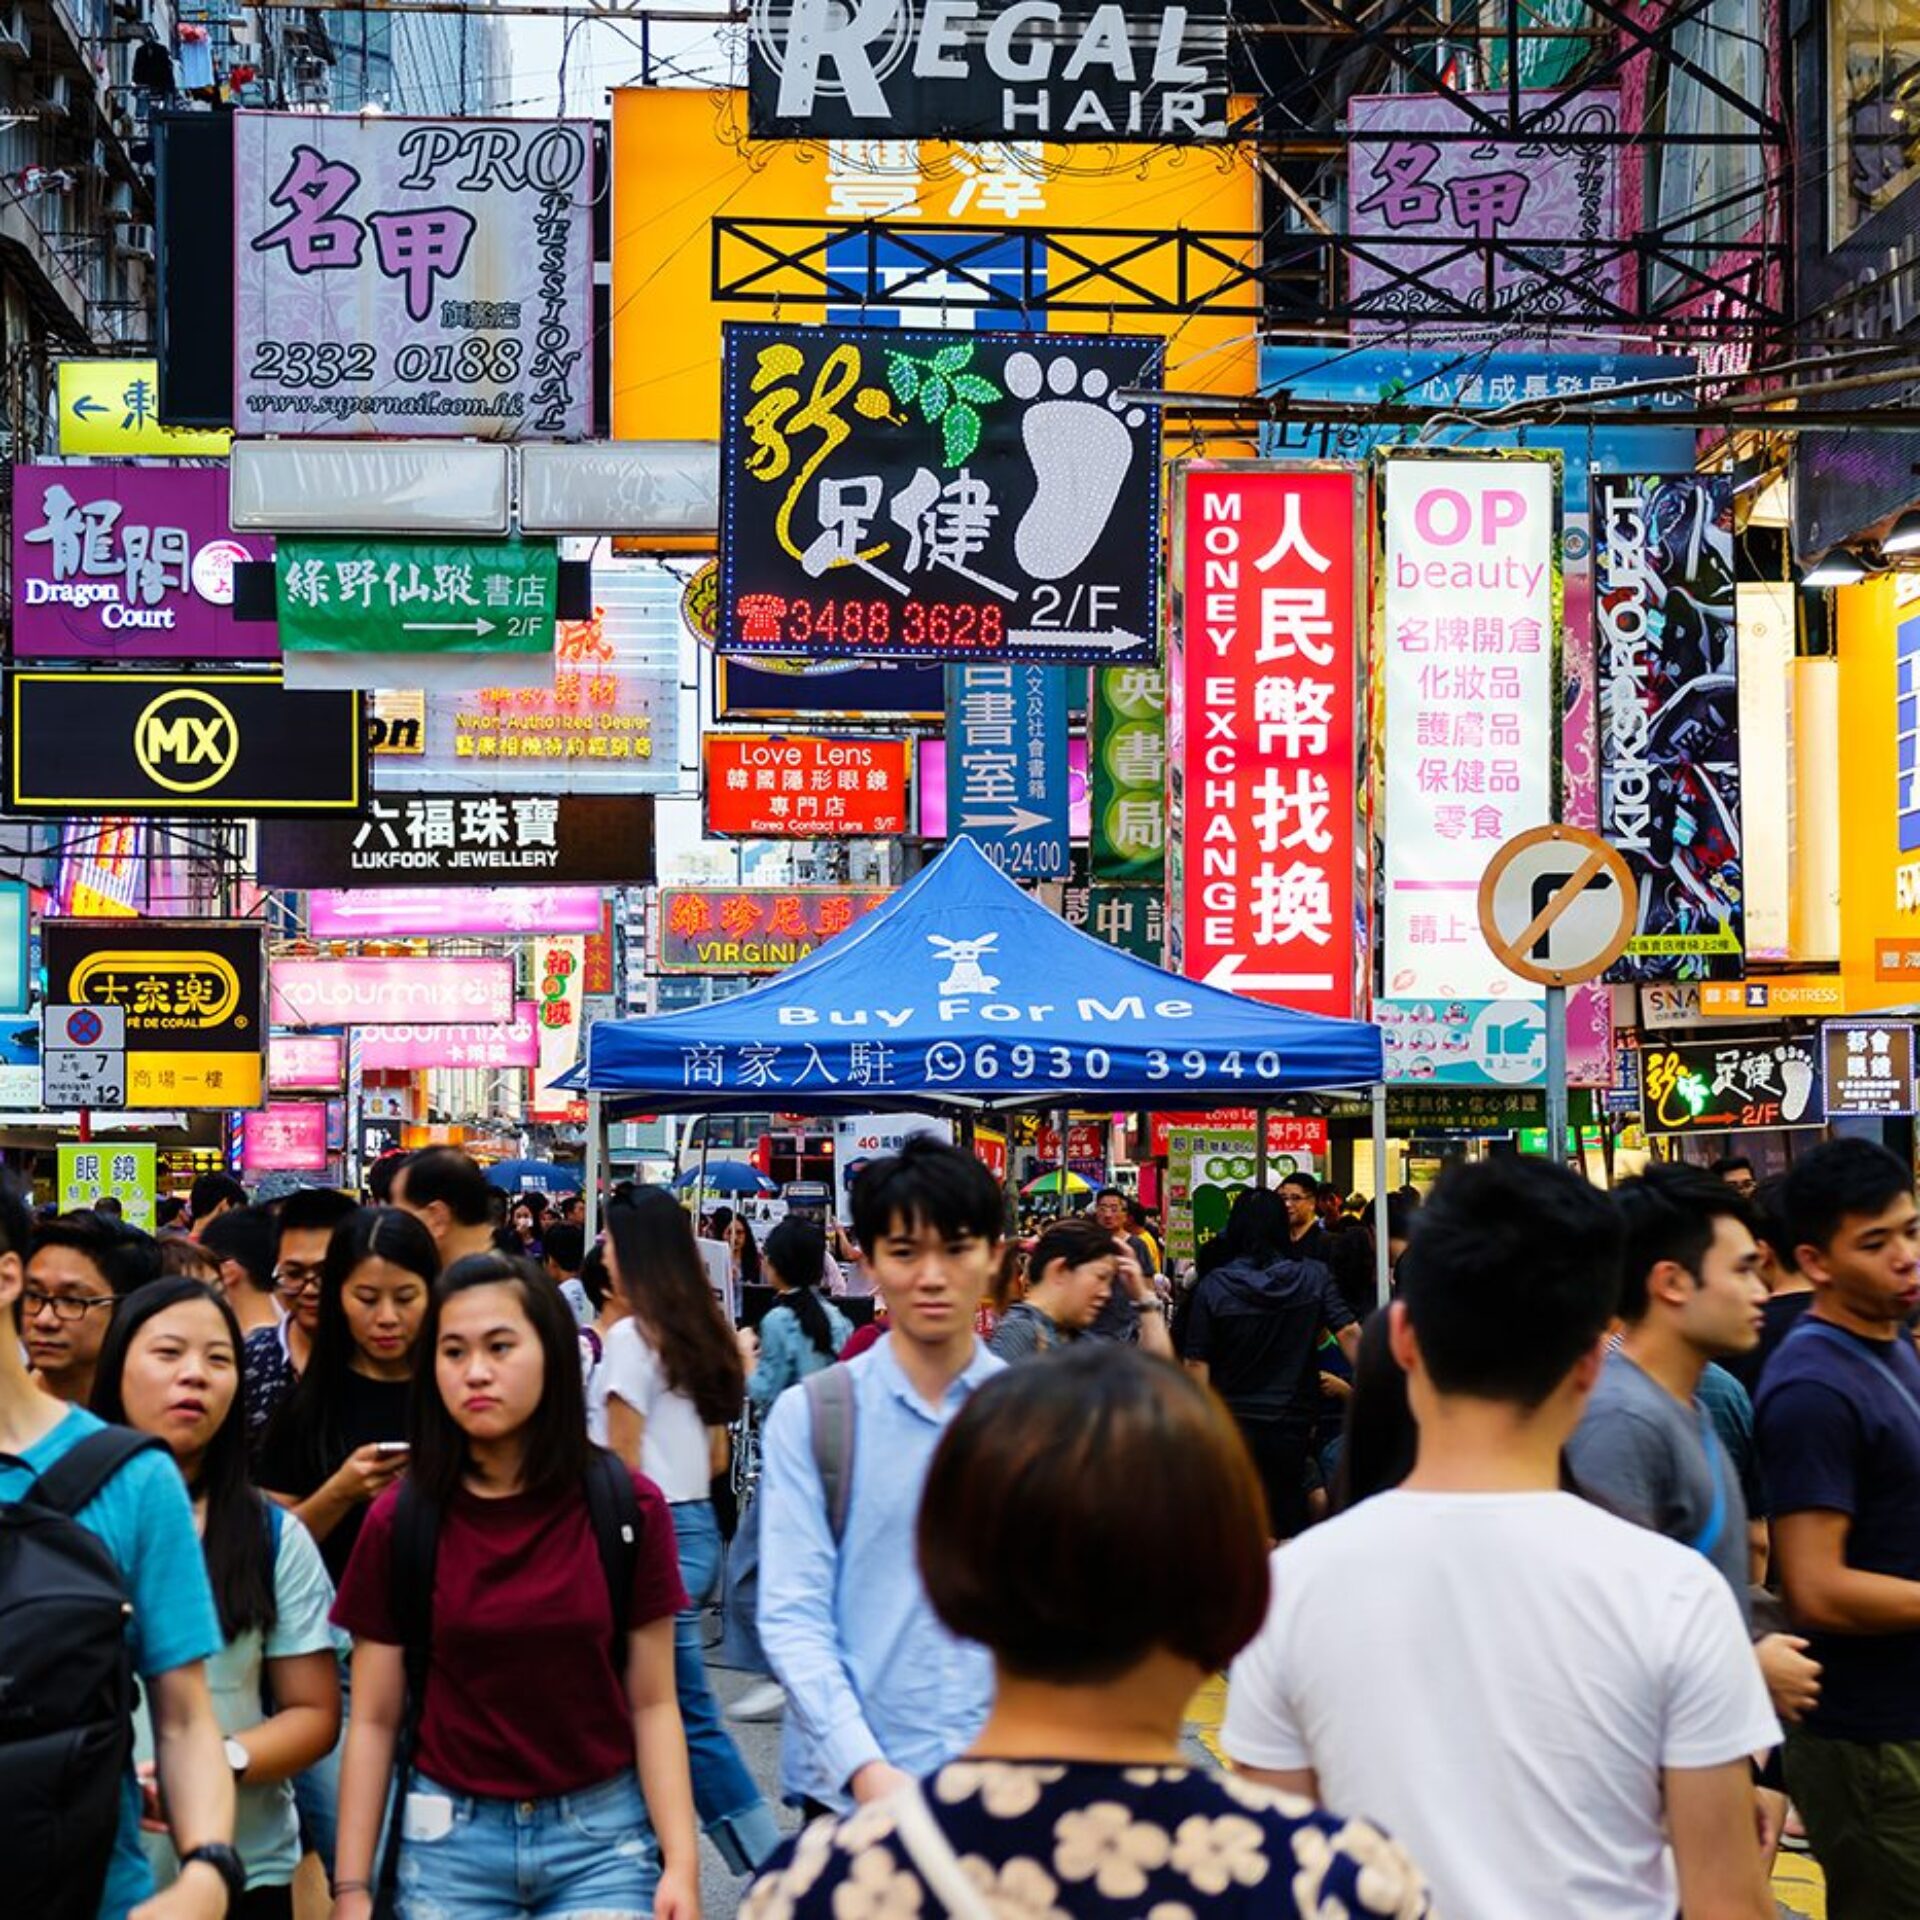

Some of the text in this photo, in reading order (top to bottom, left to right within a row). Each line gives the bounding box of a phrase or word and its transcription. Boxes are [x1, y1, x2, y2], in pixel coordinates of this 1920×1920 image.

[776, 0, 1207, 118] REGAL
[1003, 89, 1206, 133] HAIR
[399, 127, 586, 192] PRO
[251, 145, 475, 321] 名甲
[250, 337, 524, 388] 2332 0188
[247, 391, 526, 420] www.supernail.com.hk
[1414, 487, 1528, 546] OP
[25, 579, 120, 608] Dragon
[1397, 553, 1545, 598] beauty
[102, 604, 175, 629] Court
[789, 600, 1002, 647] 3488 3628
[1030, 584, 1120, 627] 2/F
[507, 616, 542, 637] 2/F
[1397, 617, 1542, 654] 名牌開倉
[601, 713, 651, 730] Dealer
[1202, 493, 1242, 946] MONEY EXCHANGE
[1252, 492, 1336, 946] 人民幣找換
[1417, 712, 1521, 748] 護膚品
[147, 718, 225, 764] MX
[740, 743, 872, 767] Love Lens
[1417, 758, 1521, 794] 保健品
[352, 798, 560, 848] 六福珠寶
[768, 796, 847, 817] 專門店
[873, 817, 897, 831] 3/F
[1434, 804, 1504, 840] 零食
[352, 851, 560, 870] LUKFOOK JEWELLERY
[697, 942, 814, 963] VIRGINIA
[779, 997, 1194, 1028] Buy For Me
[1772, 987, 1839, 1003] FORTRESS
[96, 1053, 109, 1073] 7
[679, 1042, 897, 1088] 商家入駐
[973, 1044, 1282, 1081] 6930 3940
[96, 1085, 121, 1104] 12
[1742, 1102, 1781, 1126] 2/F
[76, 1155, 136, 1181] 眼鏡
